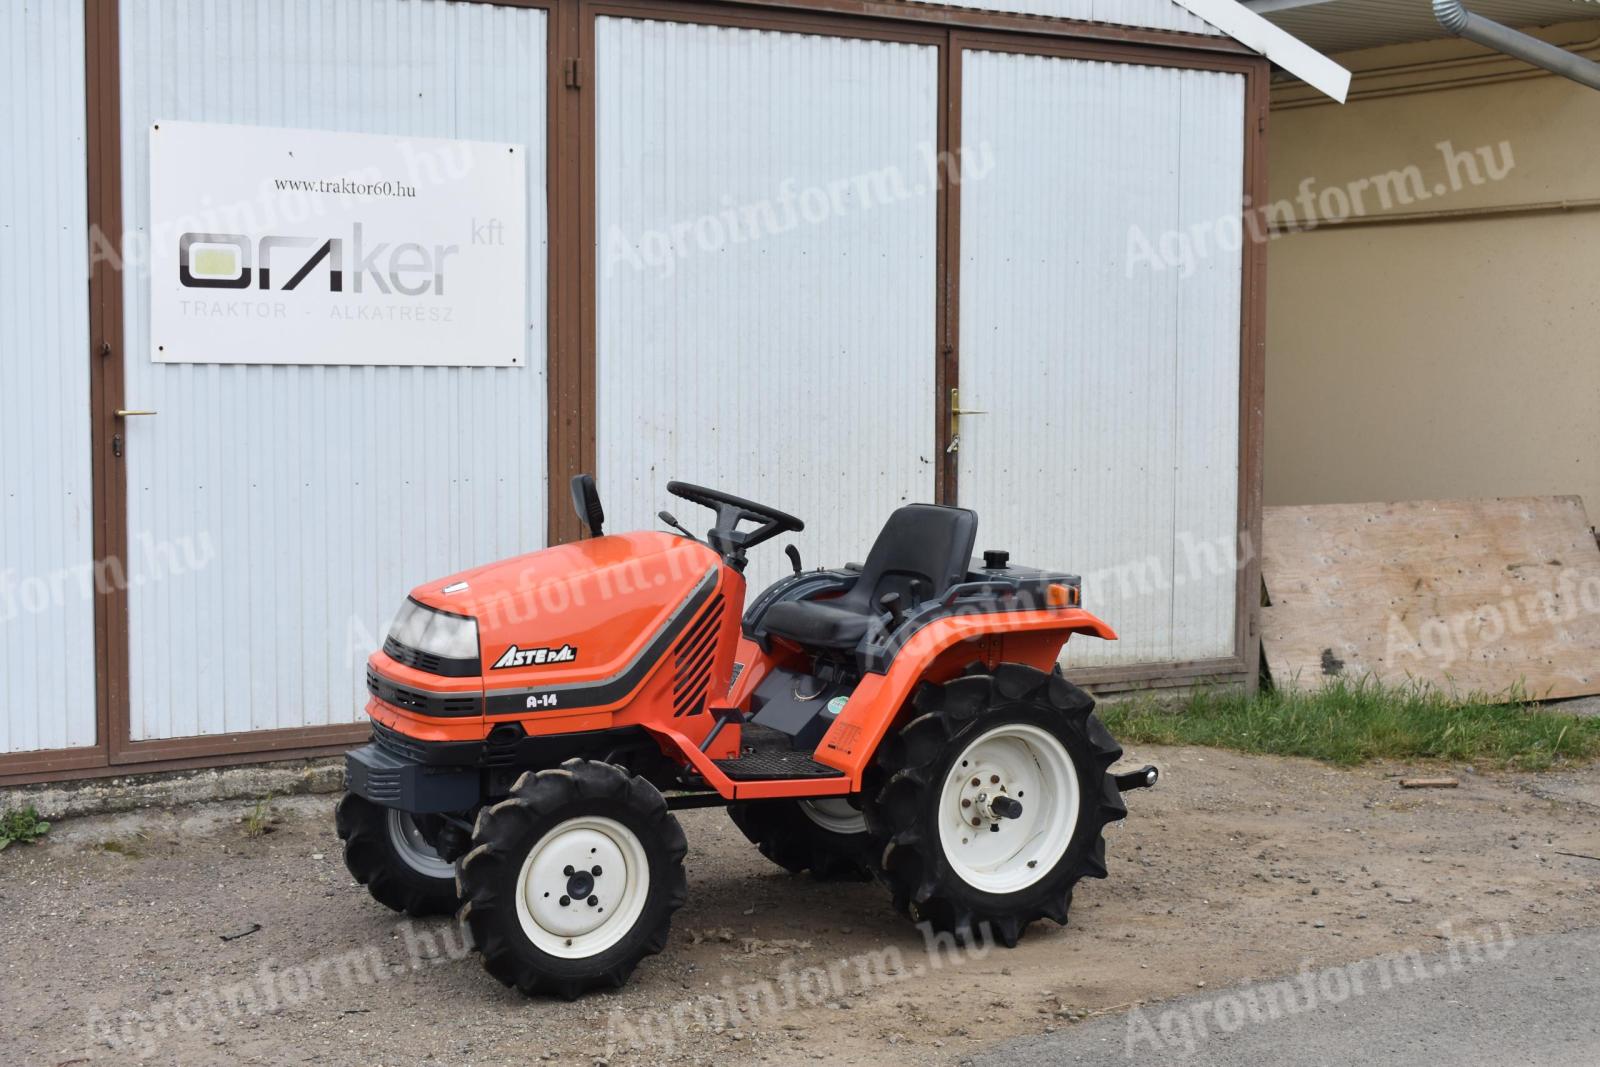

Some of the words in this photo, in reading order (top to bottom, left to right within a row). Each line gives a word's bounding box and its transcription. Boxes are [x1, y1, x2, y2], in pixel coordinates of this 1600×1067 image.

[274, 177, 416, 197] www.traktor60.hu
[471, 217, 505, 246] kft
[180, 299, 287, 318] TRAKTOR
[329, 302, 454, 321] ALKATRÉSZ
[526, 693, 557, 709] A-14
